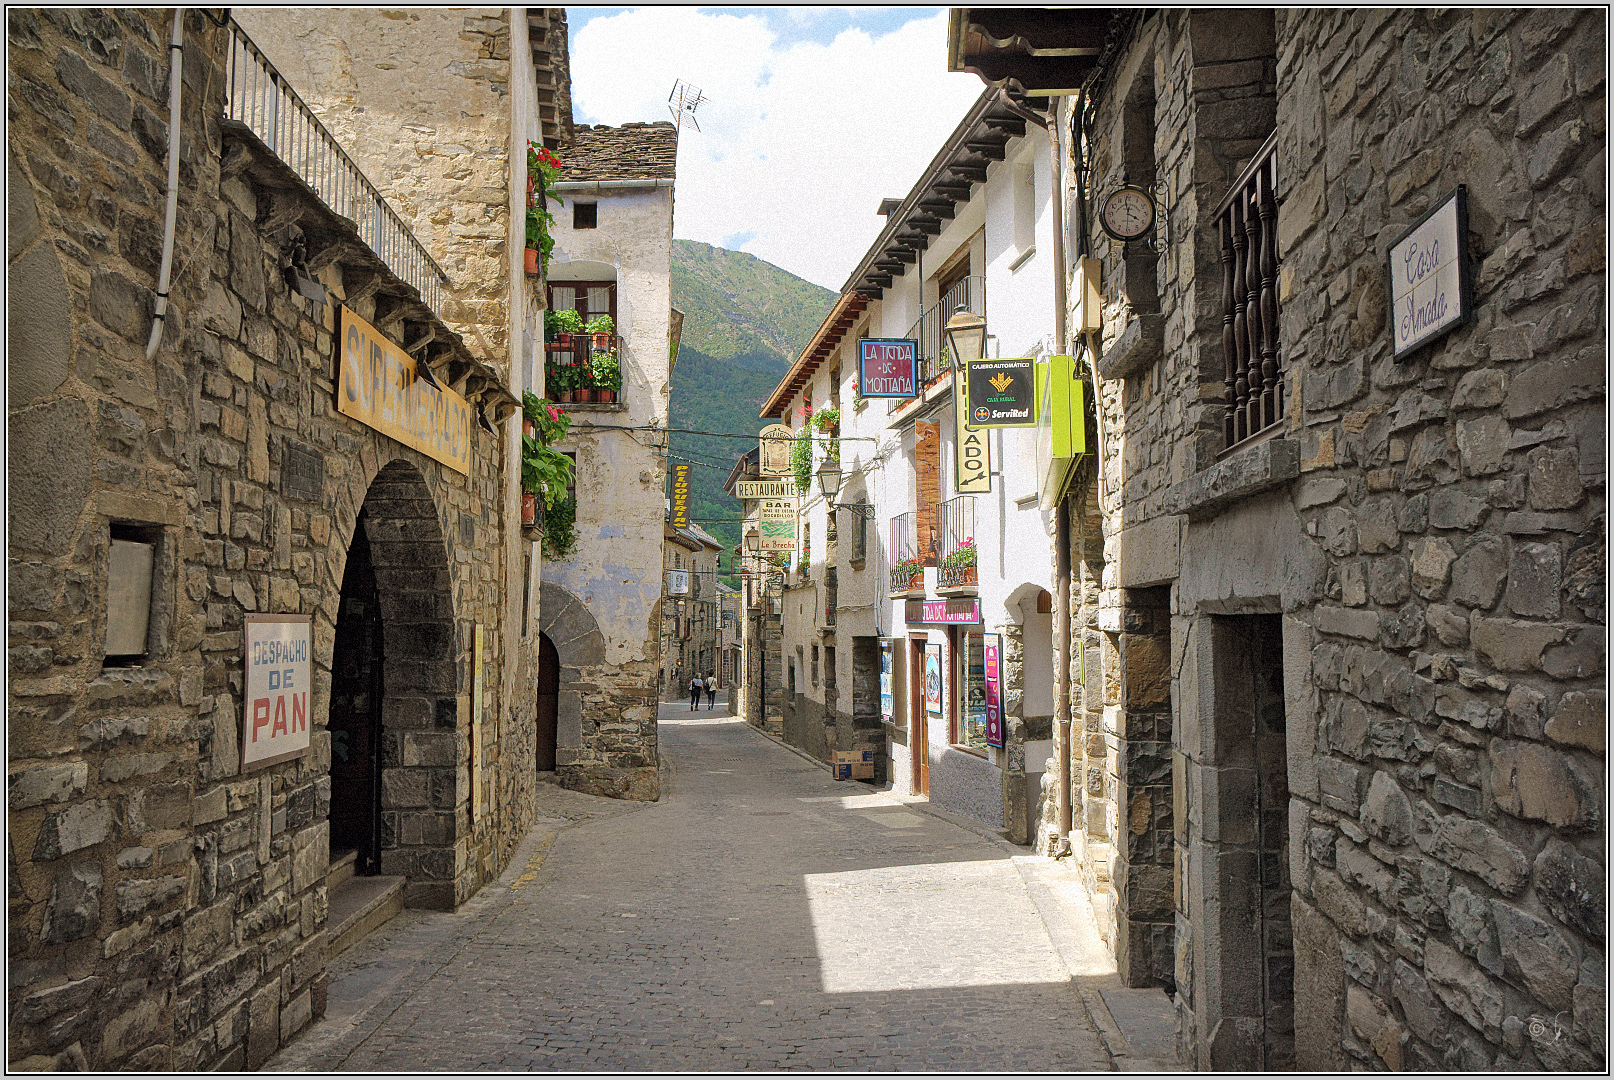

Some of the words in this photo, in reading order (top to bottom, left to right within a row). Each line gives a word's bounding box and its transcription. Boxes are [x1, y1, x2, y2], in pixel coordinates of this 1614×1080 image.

[1404, 239, 1439, 284] Casa
[864, 345, 878, 360] LA
[882, 362, 893, 374] DE
[993, 361, 1030, 369] AUTOMÁTICO
[865, 376, 913, 393] MONTAÑA
[345, 323, 468, 464] SUPERMERCADO
[991, 407, 1030, 419] ServiRed
[738, 483, 795, 496] RESTAURANTE
[771, 539, 795, 549] Brecha
[253, 639, 307, 666] DESPACHO
[268, 668, 294, 690] DE
[251, 691, 307, 744] PAN
